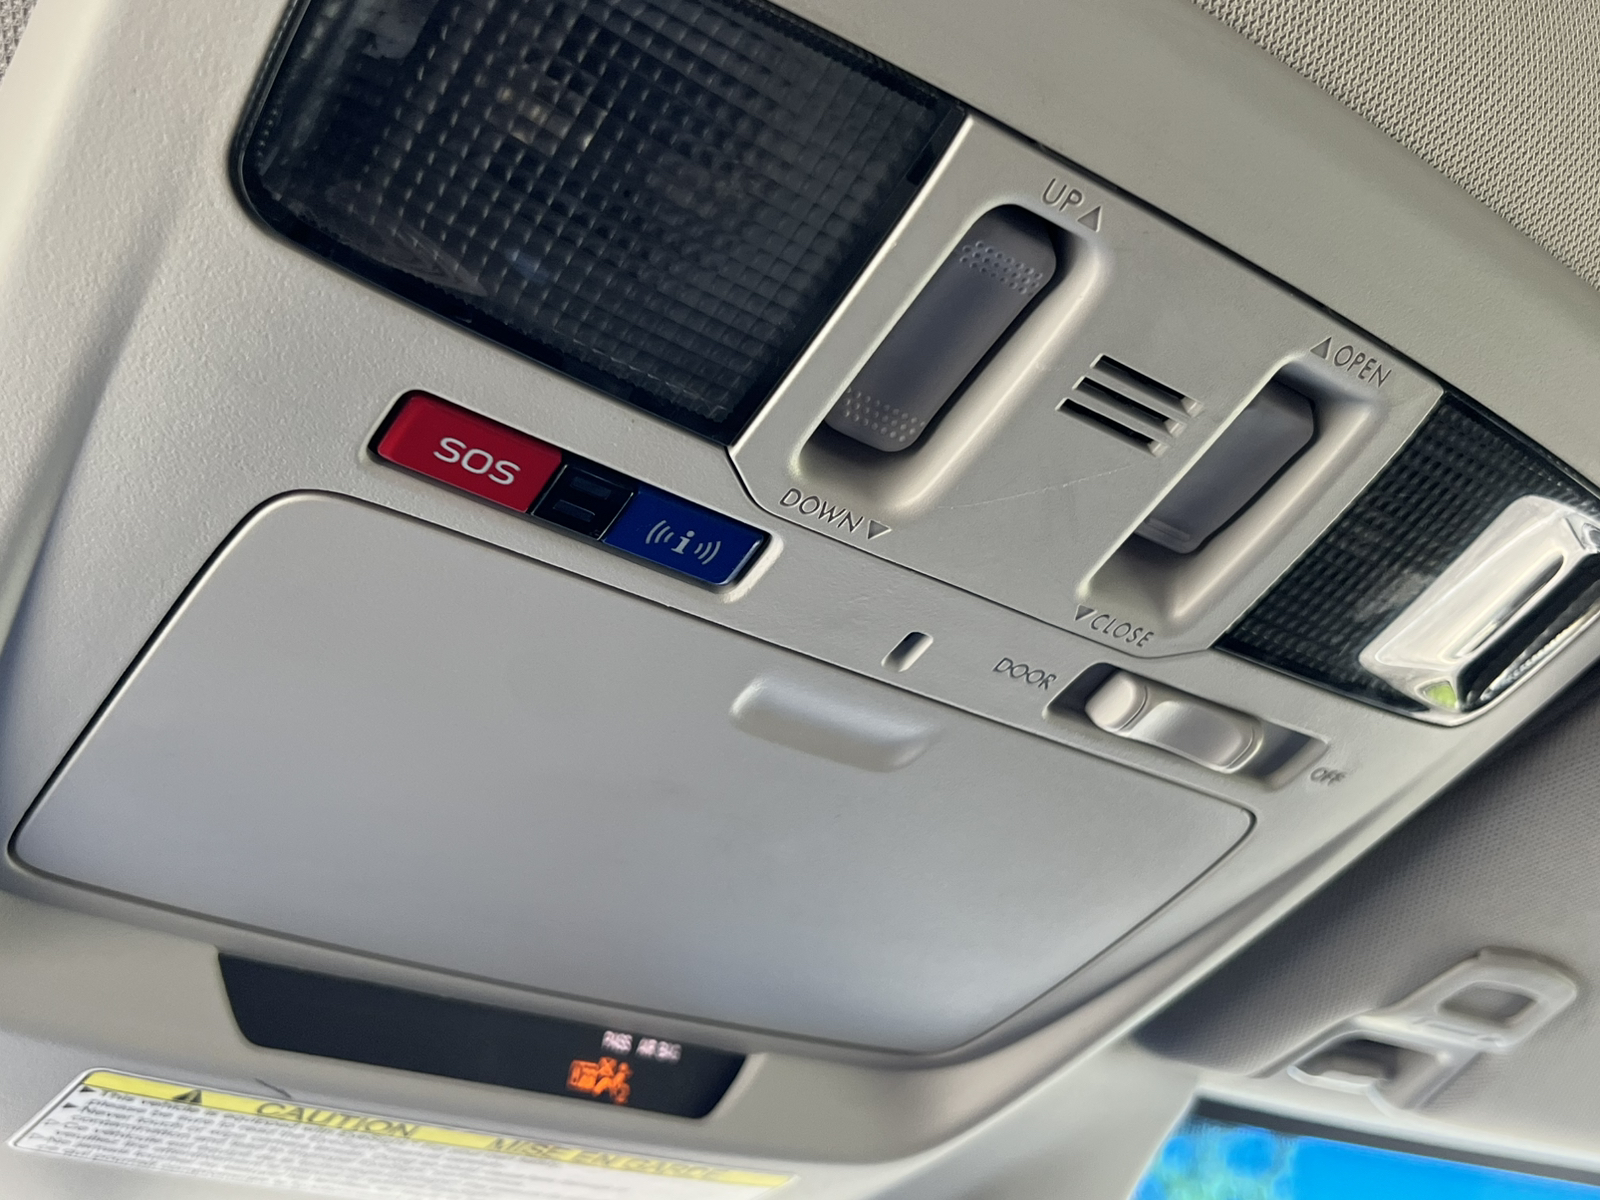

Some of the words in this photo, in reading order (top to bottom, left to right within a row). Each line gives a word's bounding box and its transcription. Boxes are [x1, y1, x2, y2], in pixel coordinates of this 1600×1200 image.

[1042, 178, 1083, 211] UP
[1334, 345, 1392, 388] OPEN
[433, 437, 520, 485] SOS
[780, 488, 865, 532] DOWN
[1090, 613, 1154, 647] CLOSE
[993, 657, 1057, 690] DOOR
[1310, 767, 1347, 787] OFF
[256, 1102, 420, 1139] CAUTION
